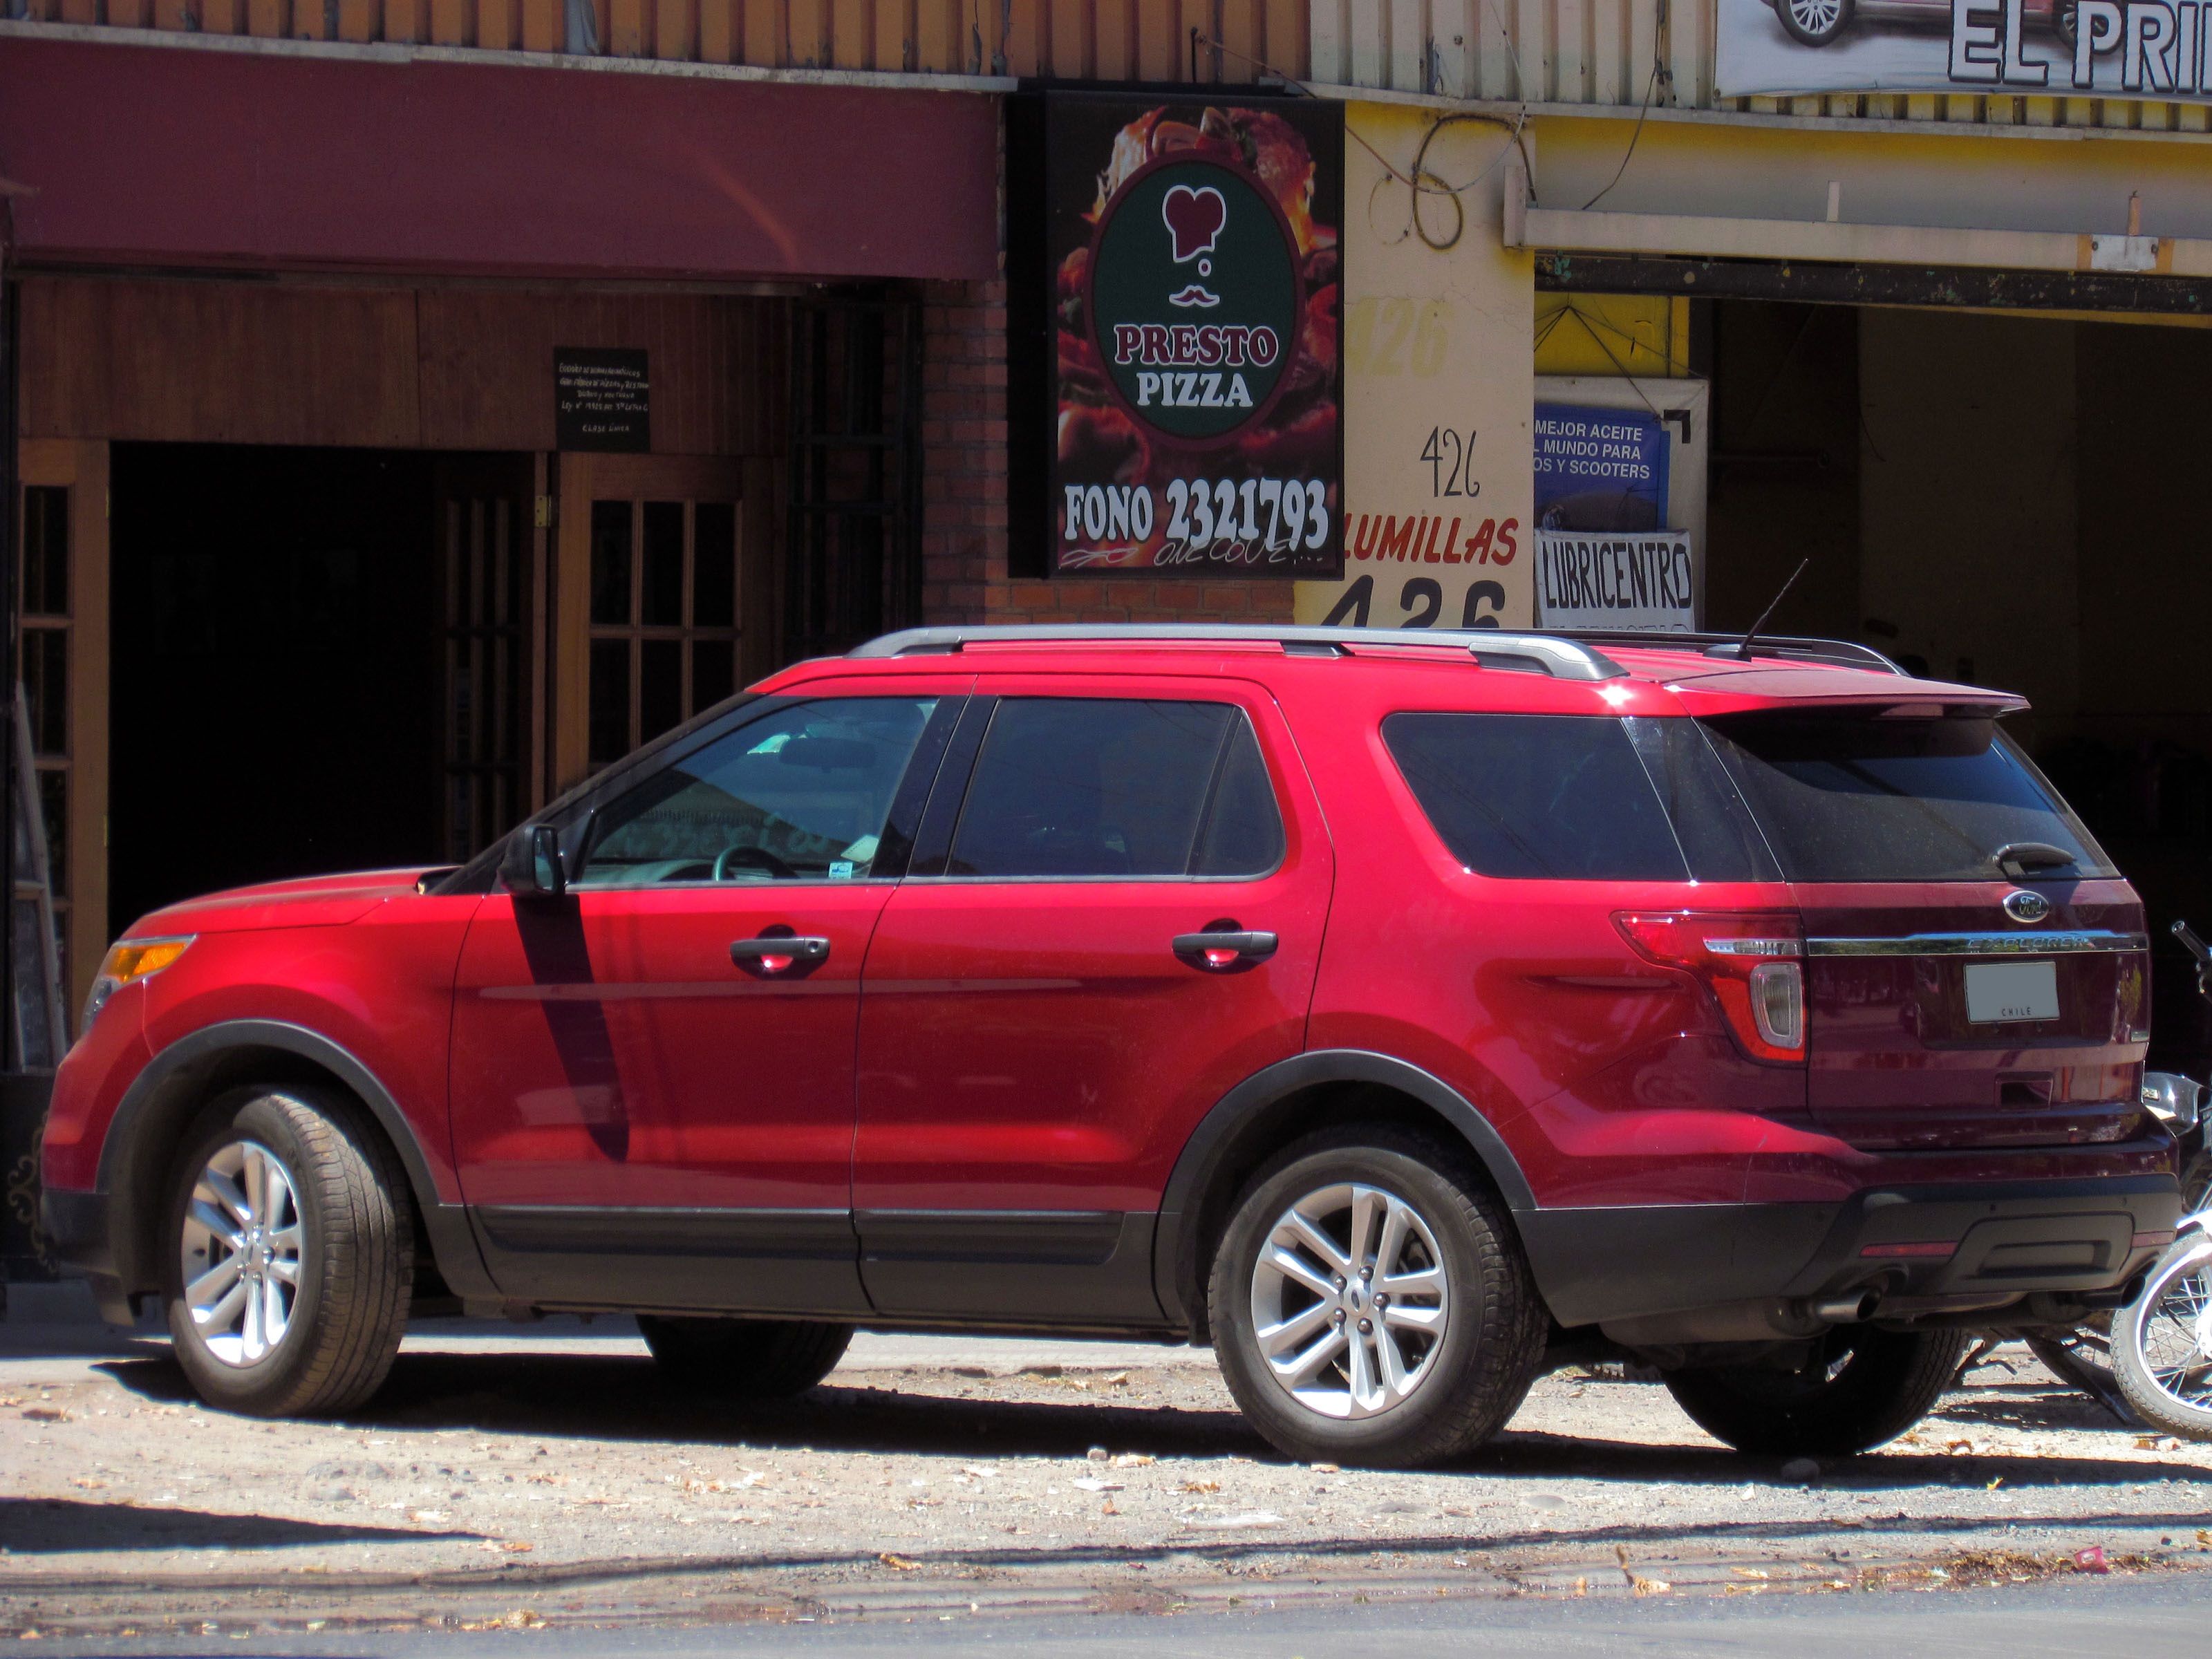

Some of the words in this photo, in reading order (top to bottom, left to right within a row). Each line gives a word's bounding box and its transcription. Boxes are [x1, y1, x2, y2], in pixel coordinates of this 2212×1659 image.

[1948, 0, 2049, 86] EL
[2072, 0, 2211, 94] PRI
[1114, 324, 1279, 367] PRESTO
[1136, 372, 1253, 407] PIZZA
[1535, 420, 1586, 437] MEJOR
[1590, 424, 1643, 442] ACEITE
[1544, 439, 1598, 457] MUNDO
[1602, 443, 1641, 460] PARA
[1557, 459, 1566, 473] Y
[1569, 460, 1651, 479] SCOOTERS
[1064, 485, 1153, 541] FONO
[1165, 477, 1329, 552] 2321793
[1542, 541, 1692, 609] LUBRICENTRO
[2001, 1006, 2032, 1017] CHILE
